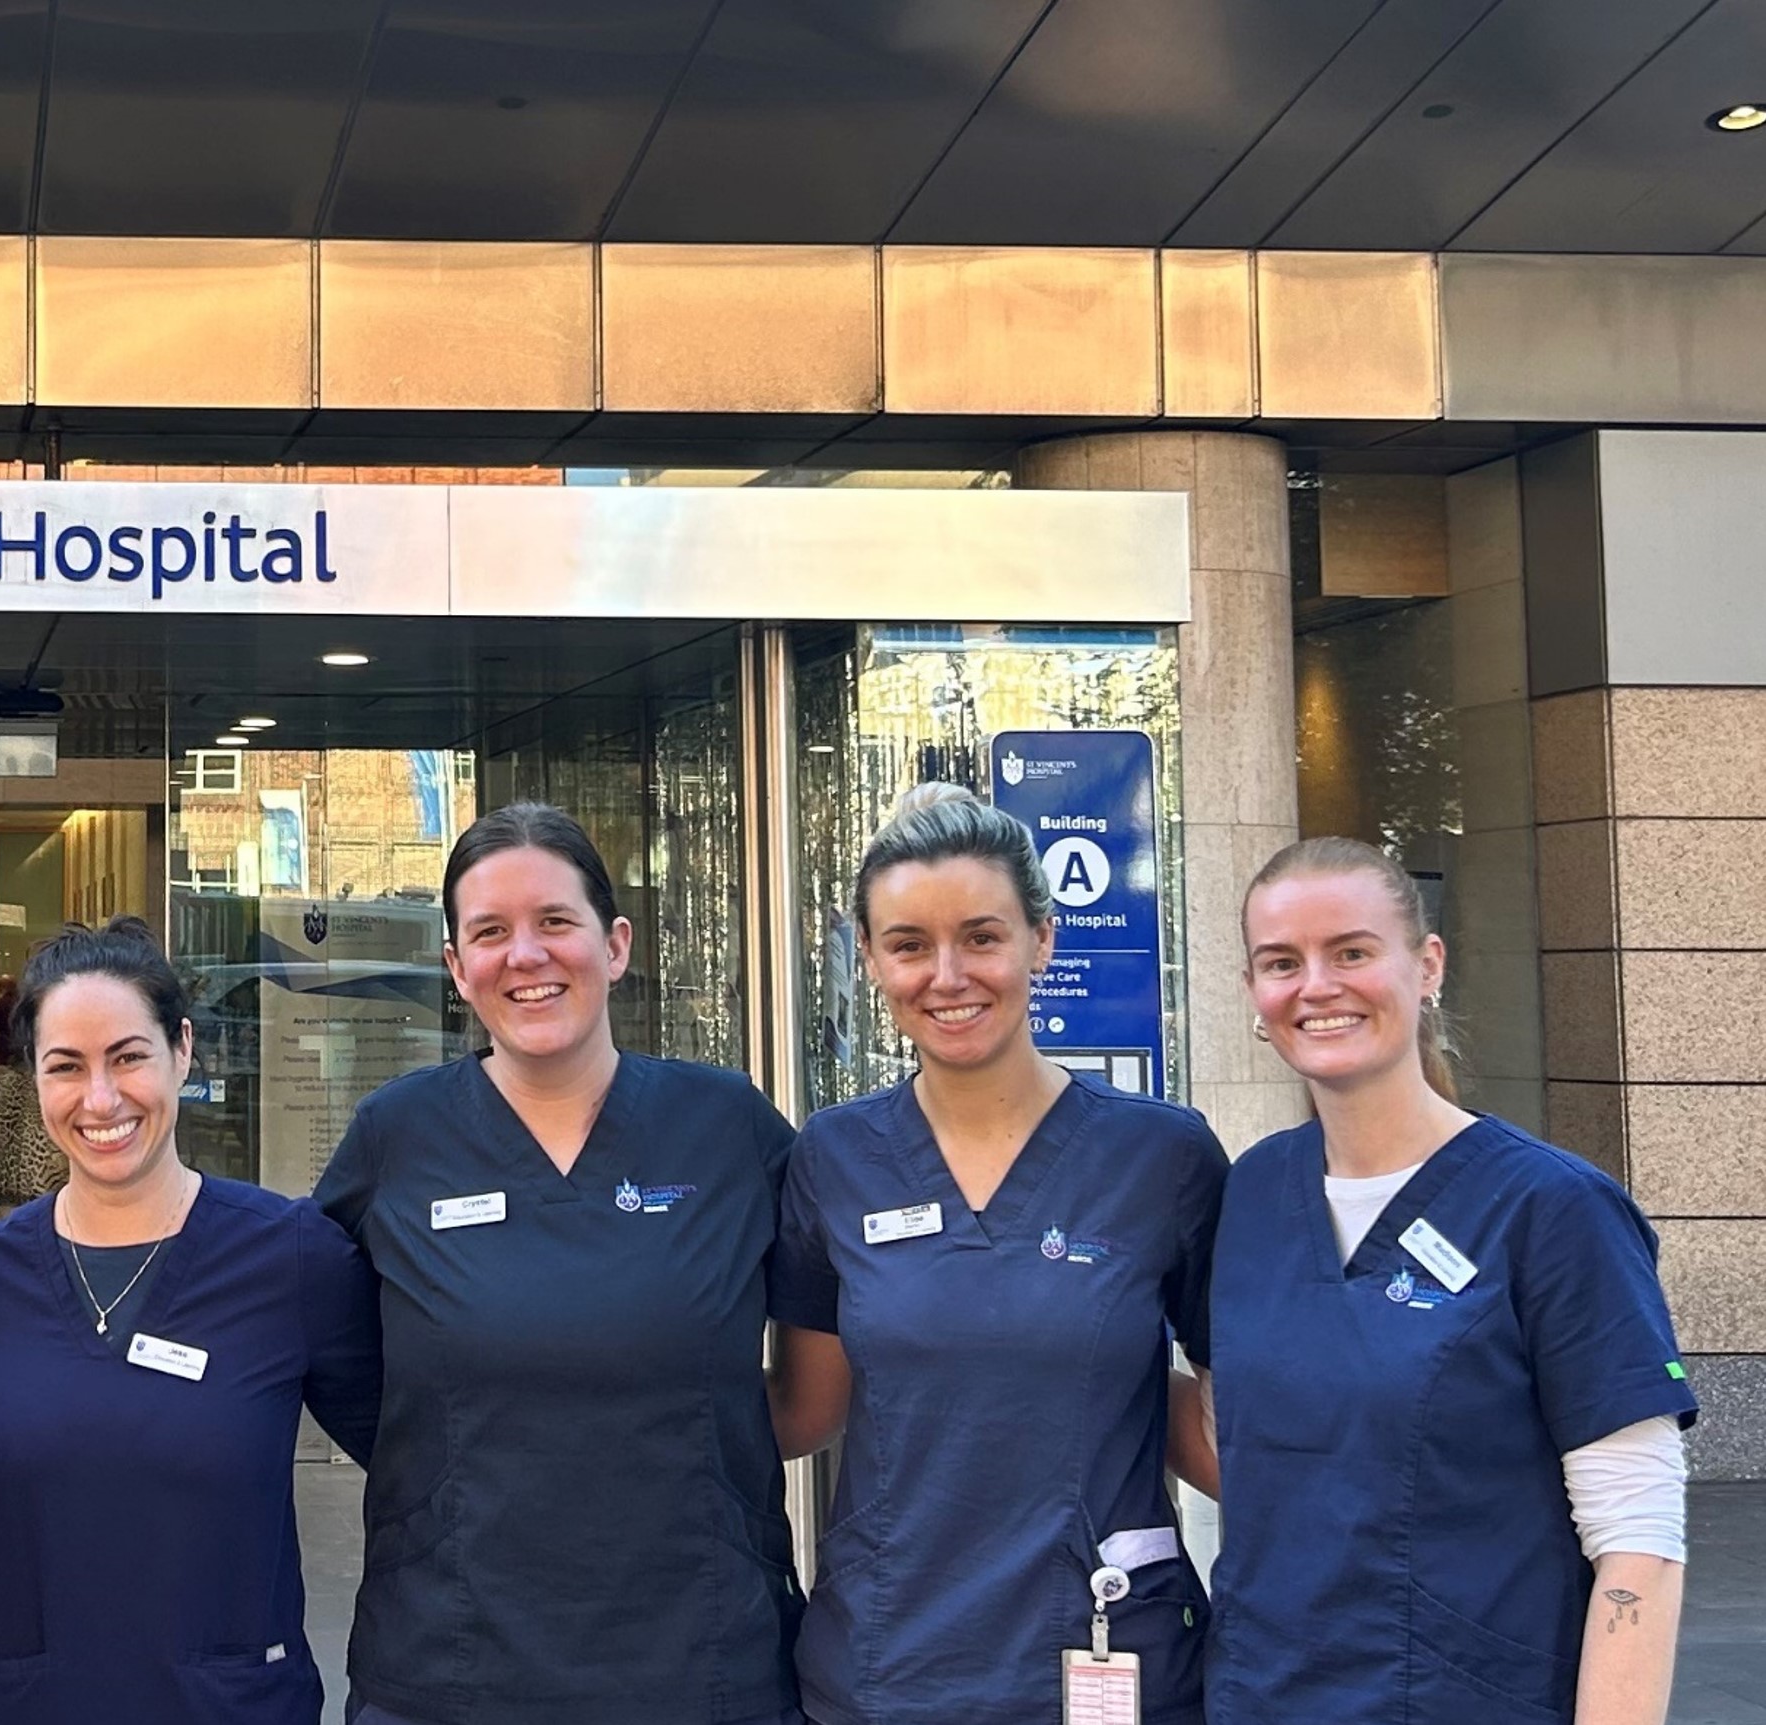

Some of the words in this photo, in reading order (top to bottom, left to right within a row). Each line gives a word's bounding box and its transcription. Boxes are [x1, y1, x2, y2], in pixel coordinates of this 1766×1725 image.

[1040, 816, 1107, 833] Building
[1058, 851, 1094, 893] A
[1065, 914, 1127, 930] Hospital
[1057, 972, 1081, 982] Care
[1030, 986, 1089, 997] Procedures
